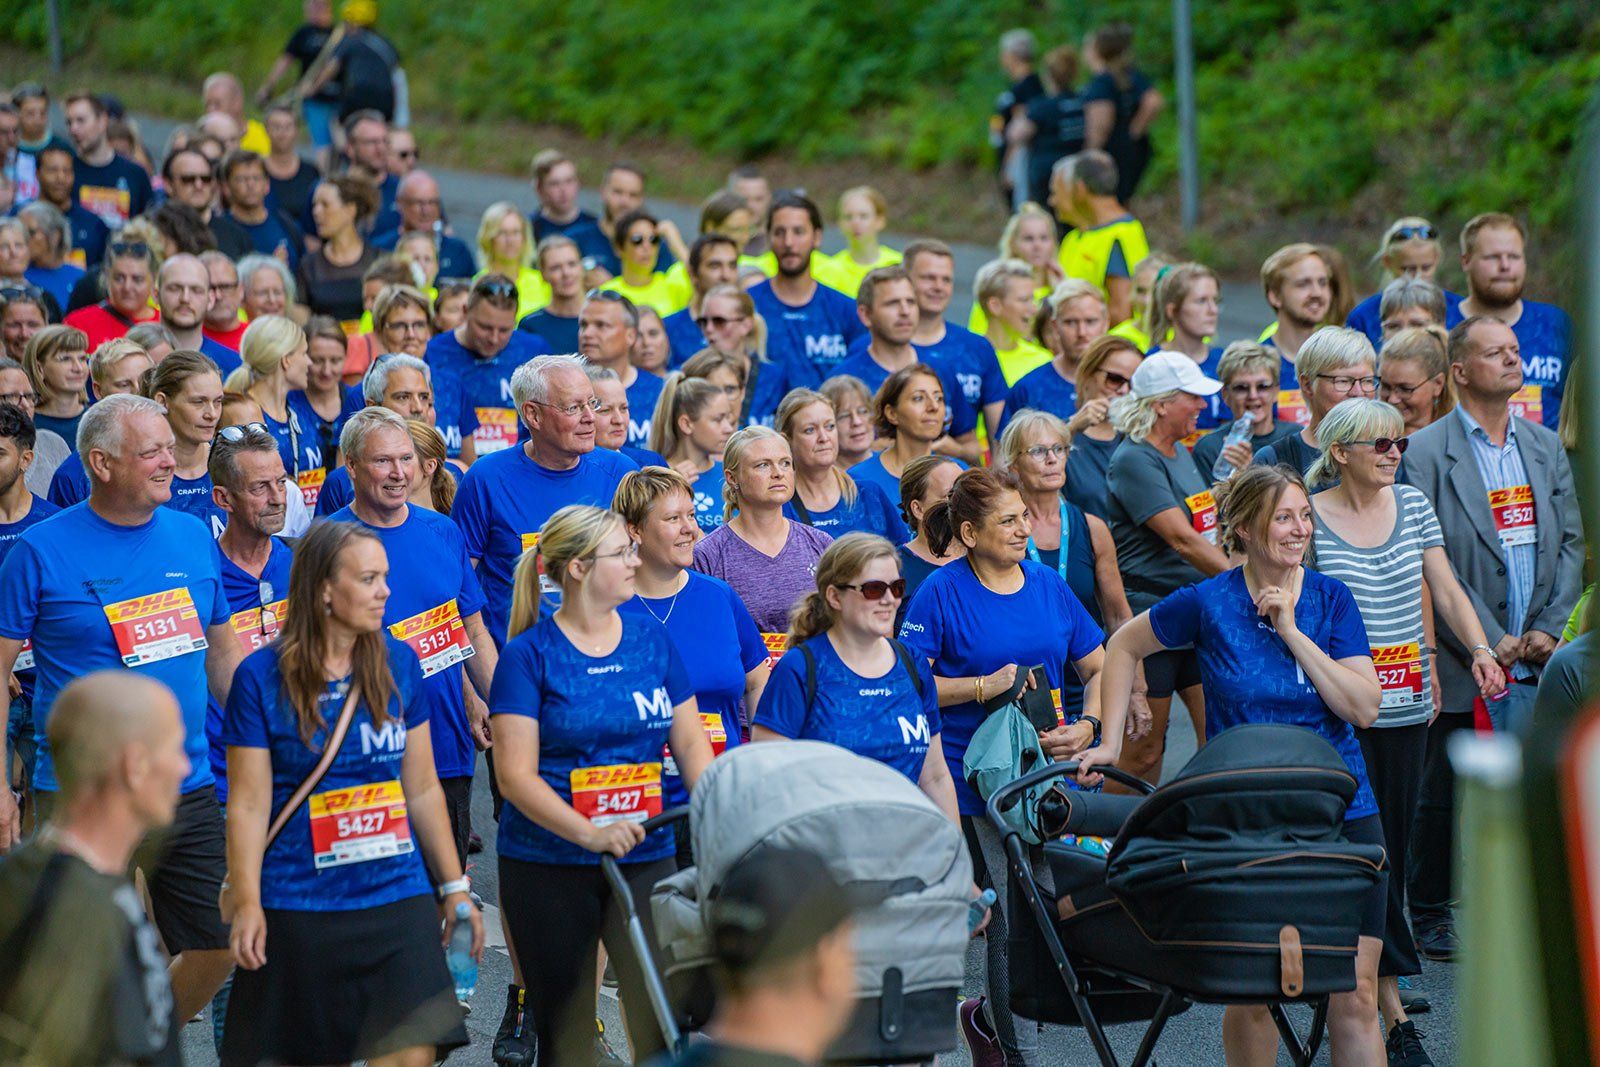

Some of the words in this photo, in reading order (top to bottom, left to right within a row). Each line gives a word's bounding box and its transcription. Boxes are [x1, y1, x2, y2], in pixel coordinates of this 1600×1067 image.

[177, 488, 202, 496] CRAFT
[117, 591, 182, 618] DHL
[134, 616, 178, 641] 5131
[402, 604, 452, 635] DHL
[418, 627, 451, 654] 5131
[1378, 668, 1407, 686] 527
[586, 766, 650, 786] DHL
[325, 787, 392, 811] DHL
[597, 790, 642, 813] 5427
[337, 811, 386, 838] 5427
